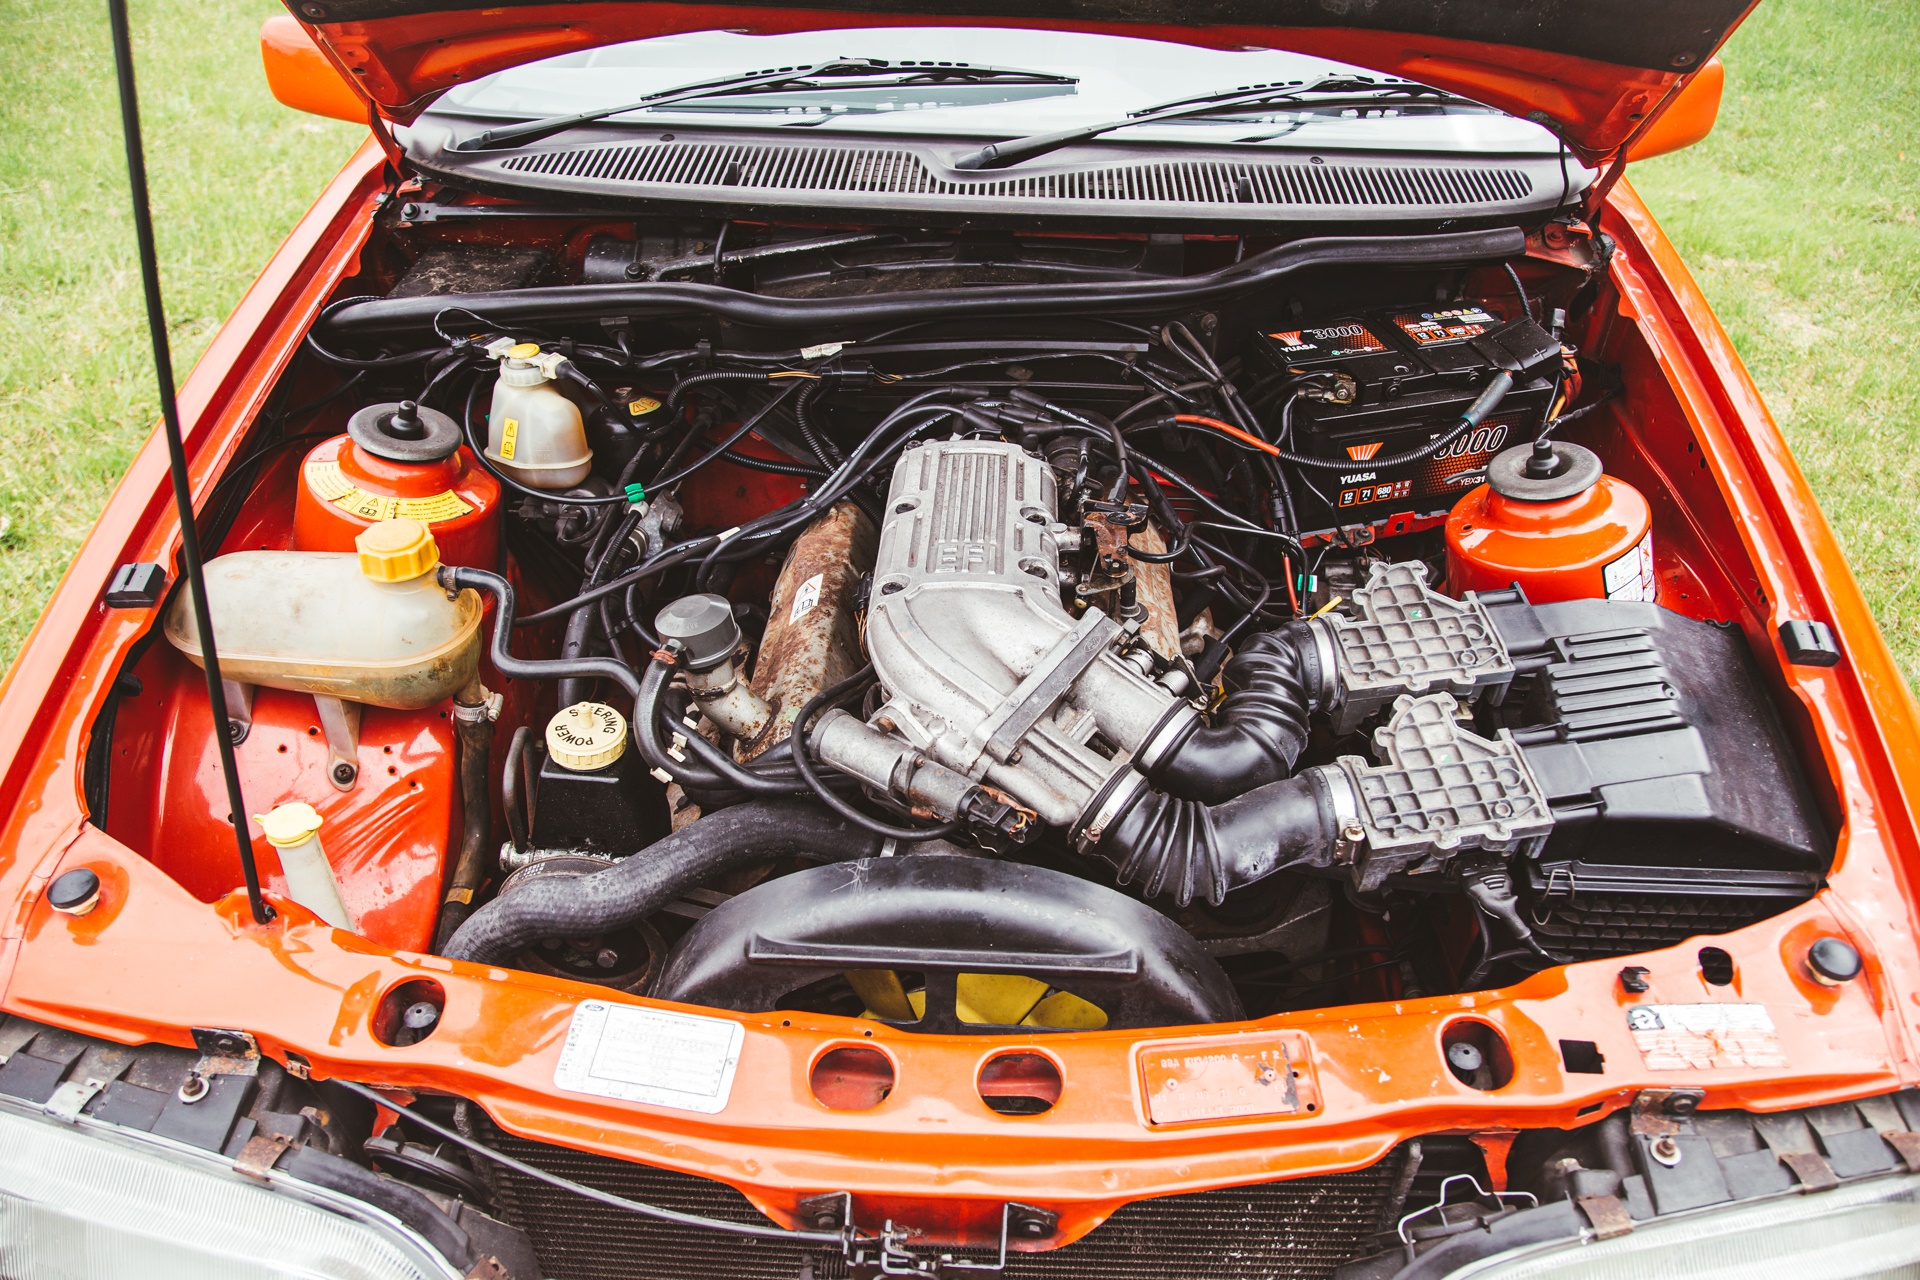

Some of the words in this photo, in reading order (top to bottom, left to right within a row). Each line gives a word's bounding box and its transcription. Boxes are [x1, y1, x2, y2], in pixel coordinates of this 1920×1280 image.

[1313, 325, 1363, 340] 3000
[1280, 343, 1318, 353] YUASA
[1340, 472, 1376, 485] YUASA
[1344, 492, 1354, 500] 12
[1362, 489, 1371, 498] 71
[1377, 486, 1391, 496] 680
[568, 706, 618, 735] SERING
[554, 724, 594, 746] POWER
